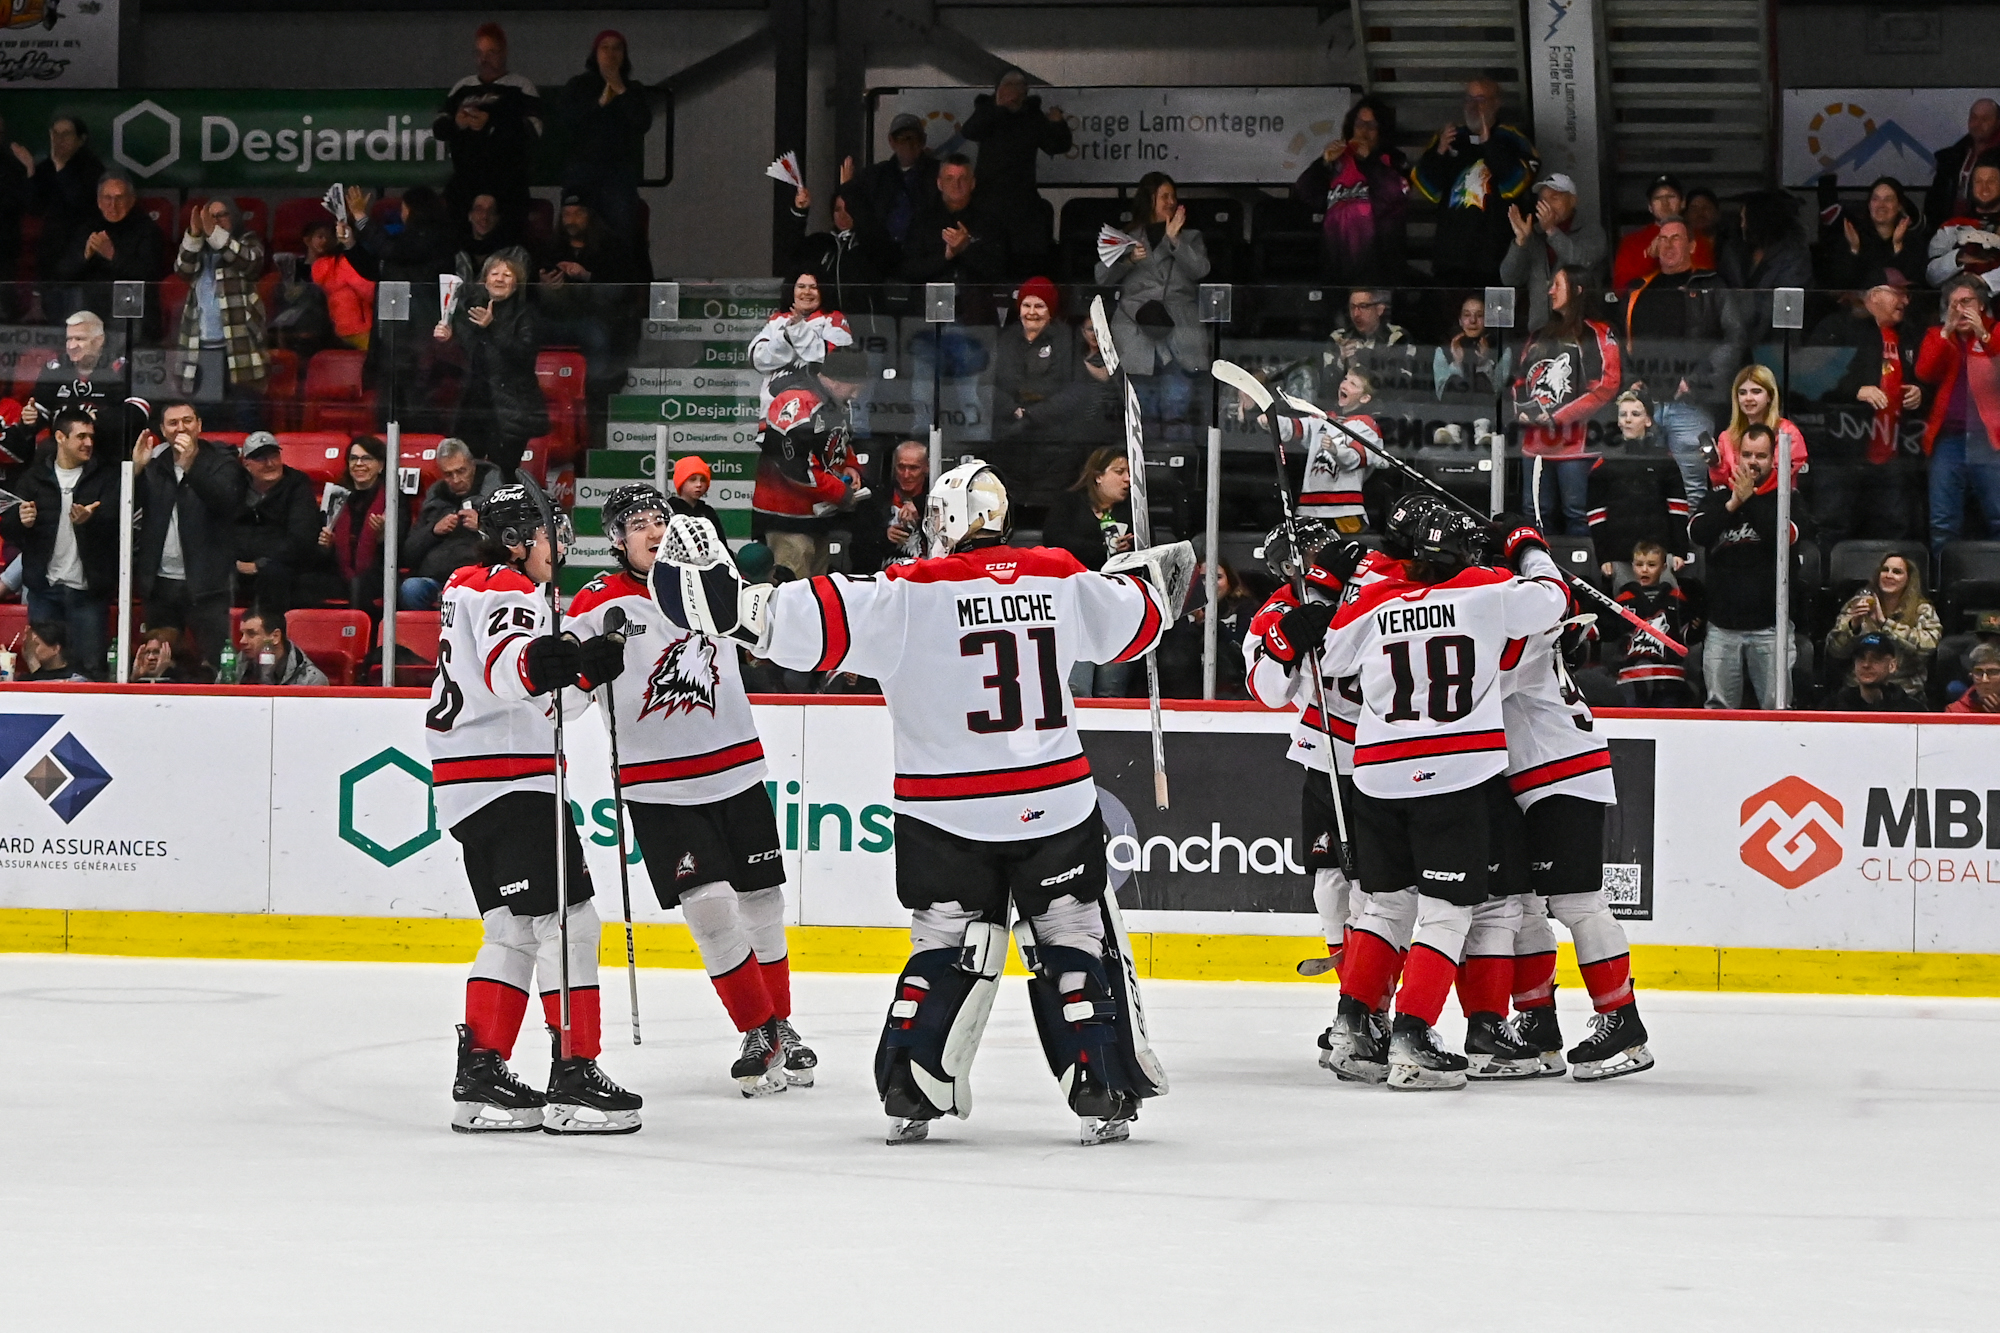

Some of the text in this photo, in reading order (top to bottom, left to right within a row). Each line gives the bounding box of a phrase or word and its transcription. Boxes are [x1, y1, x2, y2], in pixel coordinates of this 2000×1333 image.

[1065, 110, 1284, 138] orage Lamontagne
[201, 115, 446, 173] Desjardin
[1063, 139, 1131, 161] ortier
[686, 403, 760, 420] Desjardins
[489, 488, 526, 504] Ford
[986, 562, 1017, 572] CCM
[750, 594, 761, 622] CCM
[956, 595, 1057, 628] MELOCHE
[1377, 603, 1457, 636] VERDON
[488, 607, 536, 637] 26
[959, 627, 1068, 735] 31
[1382, 634, 1476, 724] 18
[42, 838, 168, 857] ASSURANCES
[73, 861, 137, 872] GÉNÉRALES
[1040, 863, 1085, 887] CCM
[1422, 869, 1466, 882] CCM
[1861, 857, 2000, 884] GLOBAL
[500, 879, 529, 897] CCM
[1609, 907, 1649, 917] HAUD.com
